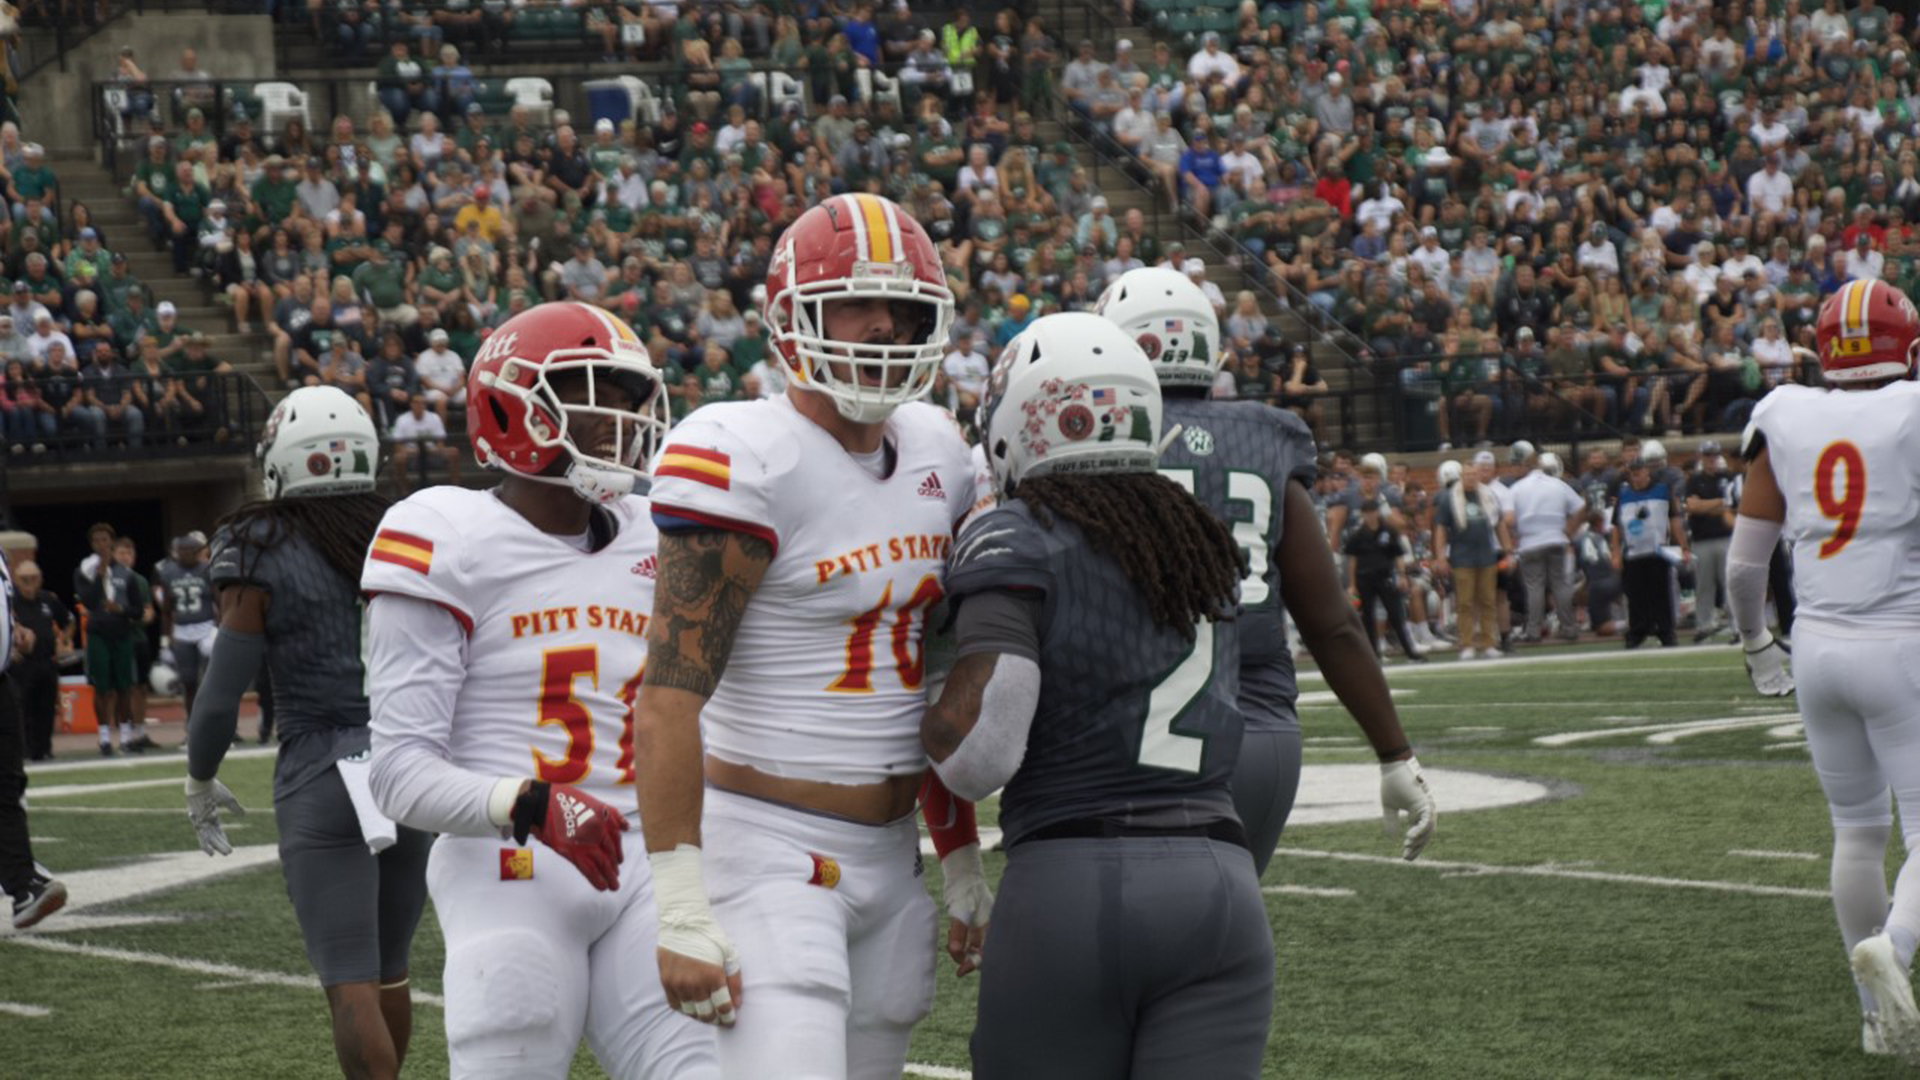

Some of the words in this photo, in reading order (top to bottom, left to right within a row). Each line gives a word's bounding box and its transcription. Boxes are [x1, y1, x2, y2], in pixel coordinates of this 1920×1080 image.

[1161, 349, 1188, 363] 63
[1099, 425, 1115, 441] 2
[1814, 439, 1867, 559] 9
[815, 544, 882, 586] PITT
[511, 606, 578, 640] PITT
[586, 604, 650, 640] STAT
[823, 575, 946, 693] 10
[1137, 611, 1214, 774] 2
[556, 792, 576, 838] adidas
